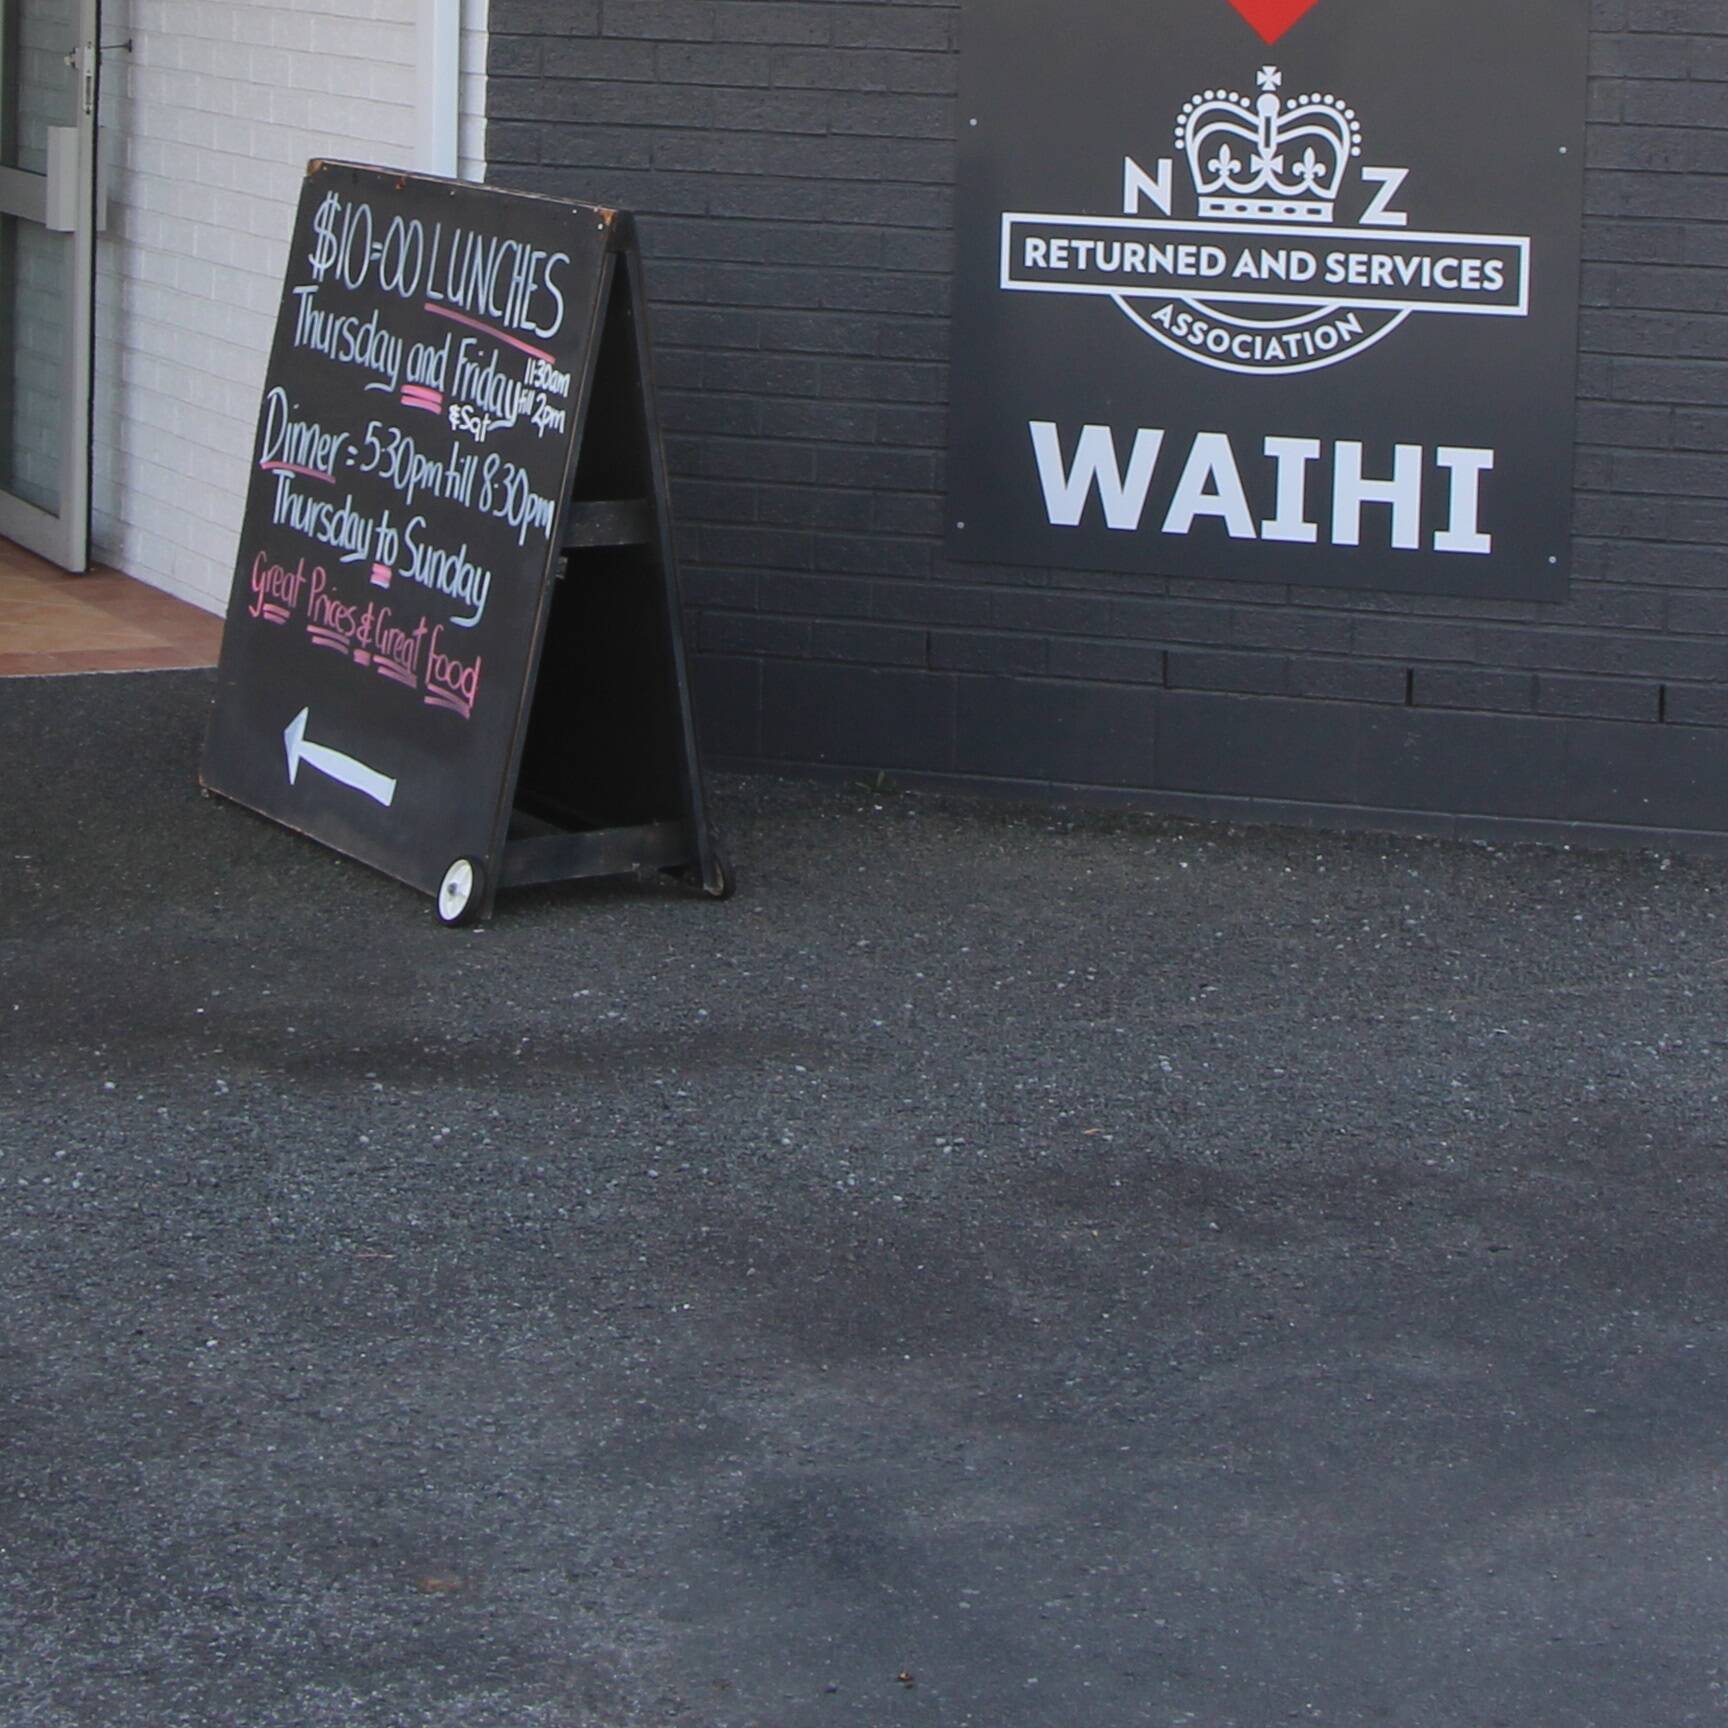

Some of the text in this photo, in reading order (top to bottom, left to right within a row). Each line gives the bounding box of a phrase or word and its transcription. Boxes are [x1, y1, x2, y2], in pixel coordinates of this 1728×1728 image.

[1123, 156, 1409, 226] N Z
[426, 222, 570, 338] LUNCHES
[1024, 236, 1505, 291] RETURNED AND SERVICES
[292, 285, 522, 430] Thursday and Friday
[1151, 302, 1364, 362] ASSOCIATION
[531, 393, 566, 438] 2pm
[444, 440, 479, 508] till
[1029, 421, 1494, 554] WAIHI
[273, 468, 491, 628] Thursday to Sunday
[248, 550, 306, 618] Great
[307, 566, 356, 637] Prices
[356, 602, 375, 649] &
[374, 607, 427, 672] Great
